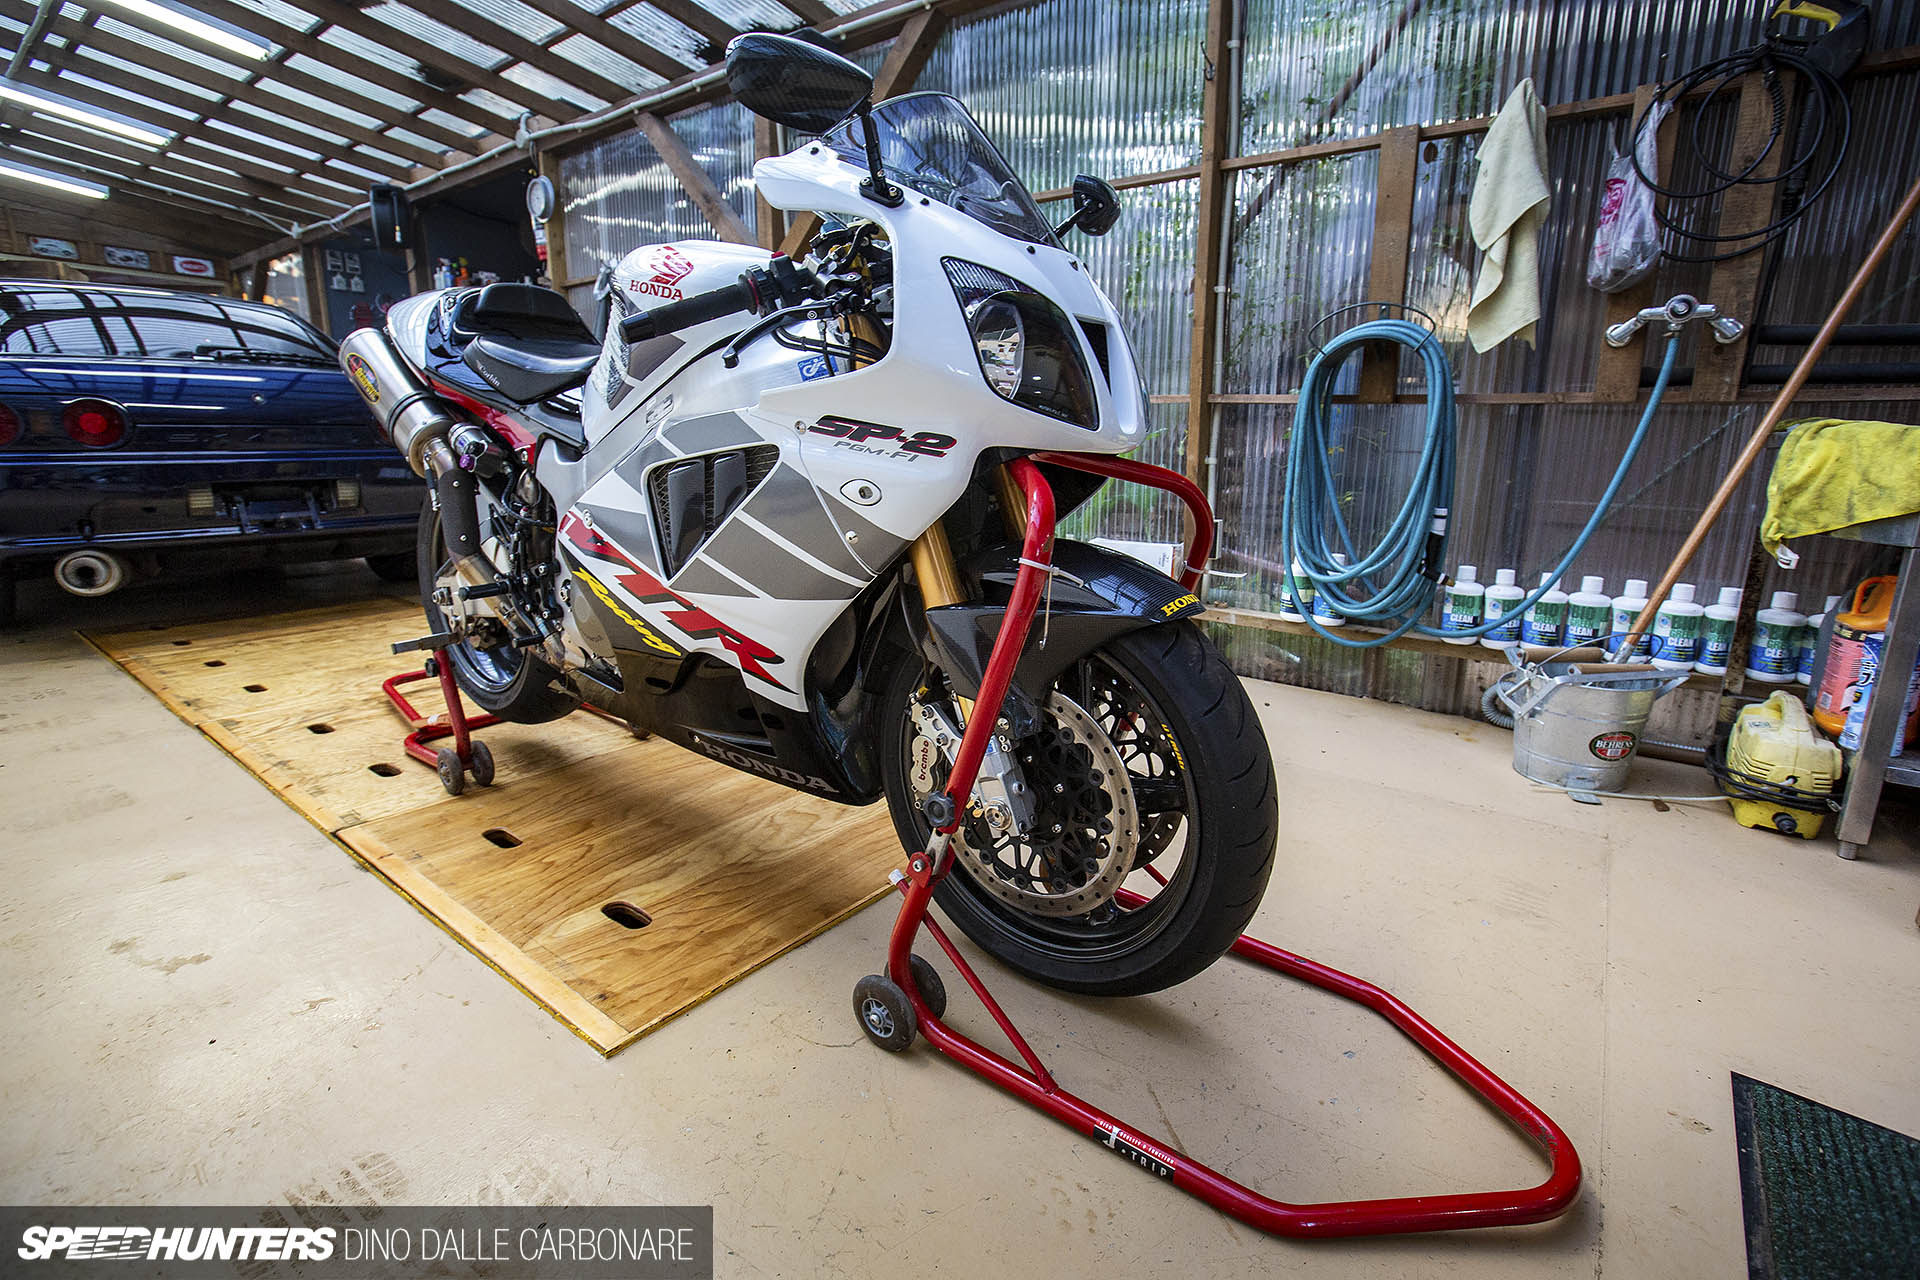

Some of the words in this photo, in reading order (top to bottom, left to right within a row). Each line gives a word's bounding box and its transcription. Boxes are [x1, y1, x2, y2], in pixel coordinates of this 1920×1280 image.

[629, 280, 683, 301] HONDA
[807, 414, 957, 458] SP-2
[559, 510, 799, 695] VTR
[572, 567, 681, 656] Racing
[1450, 613, 1473, 624] CLEAN
[1532, 622, 1557, 633] CLEAN
[1568, 625, 1593, 636] CLEAN
[1667, 637, 1694, 647] CLEAN
[700, 740, 840, 793] HONDA
[918, 740, 929, 780] brembo
